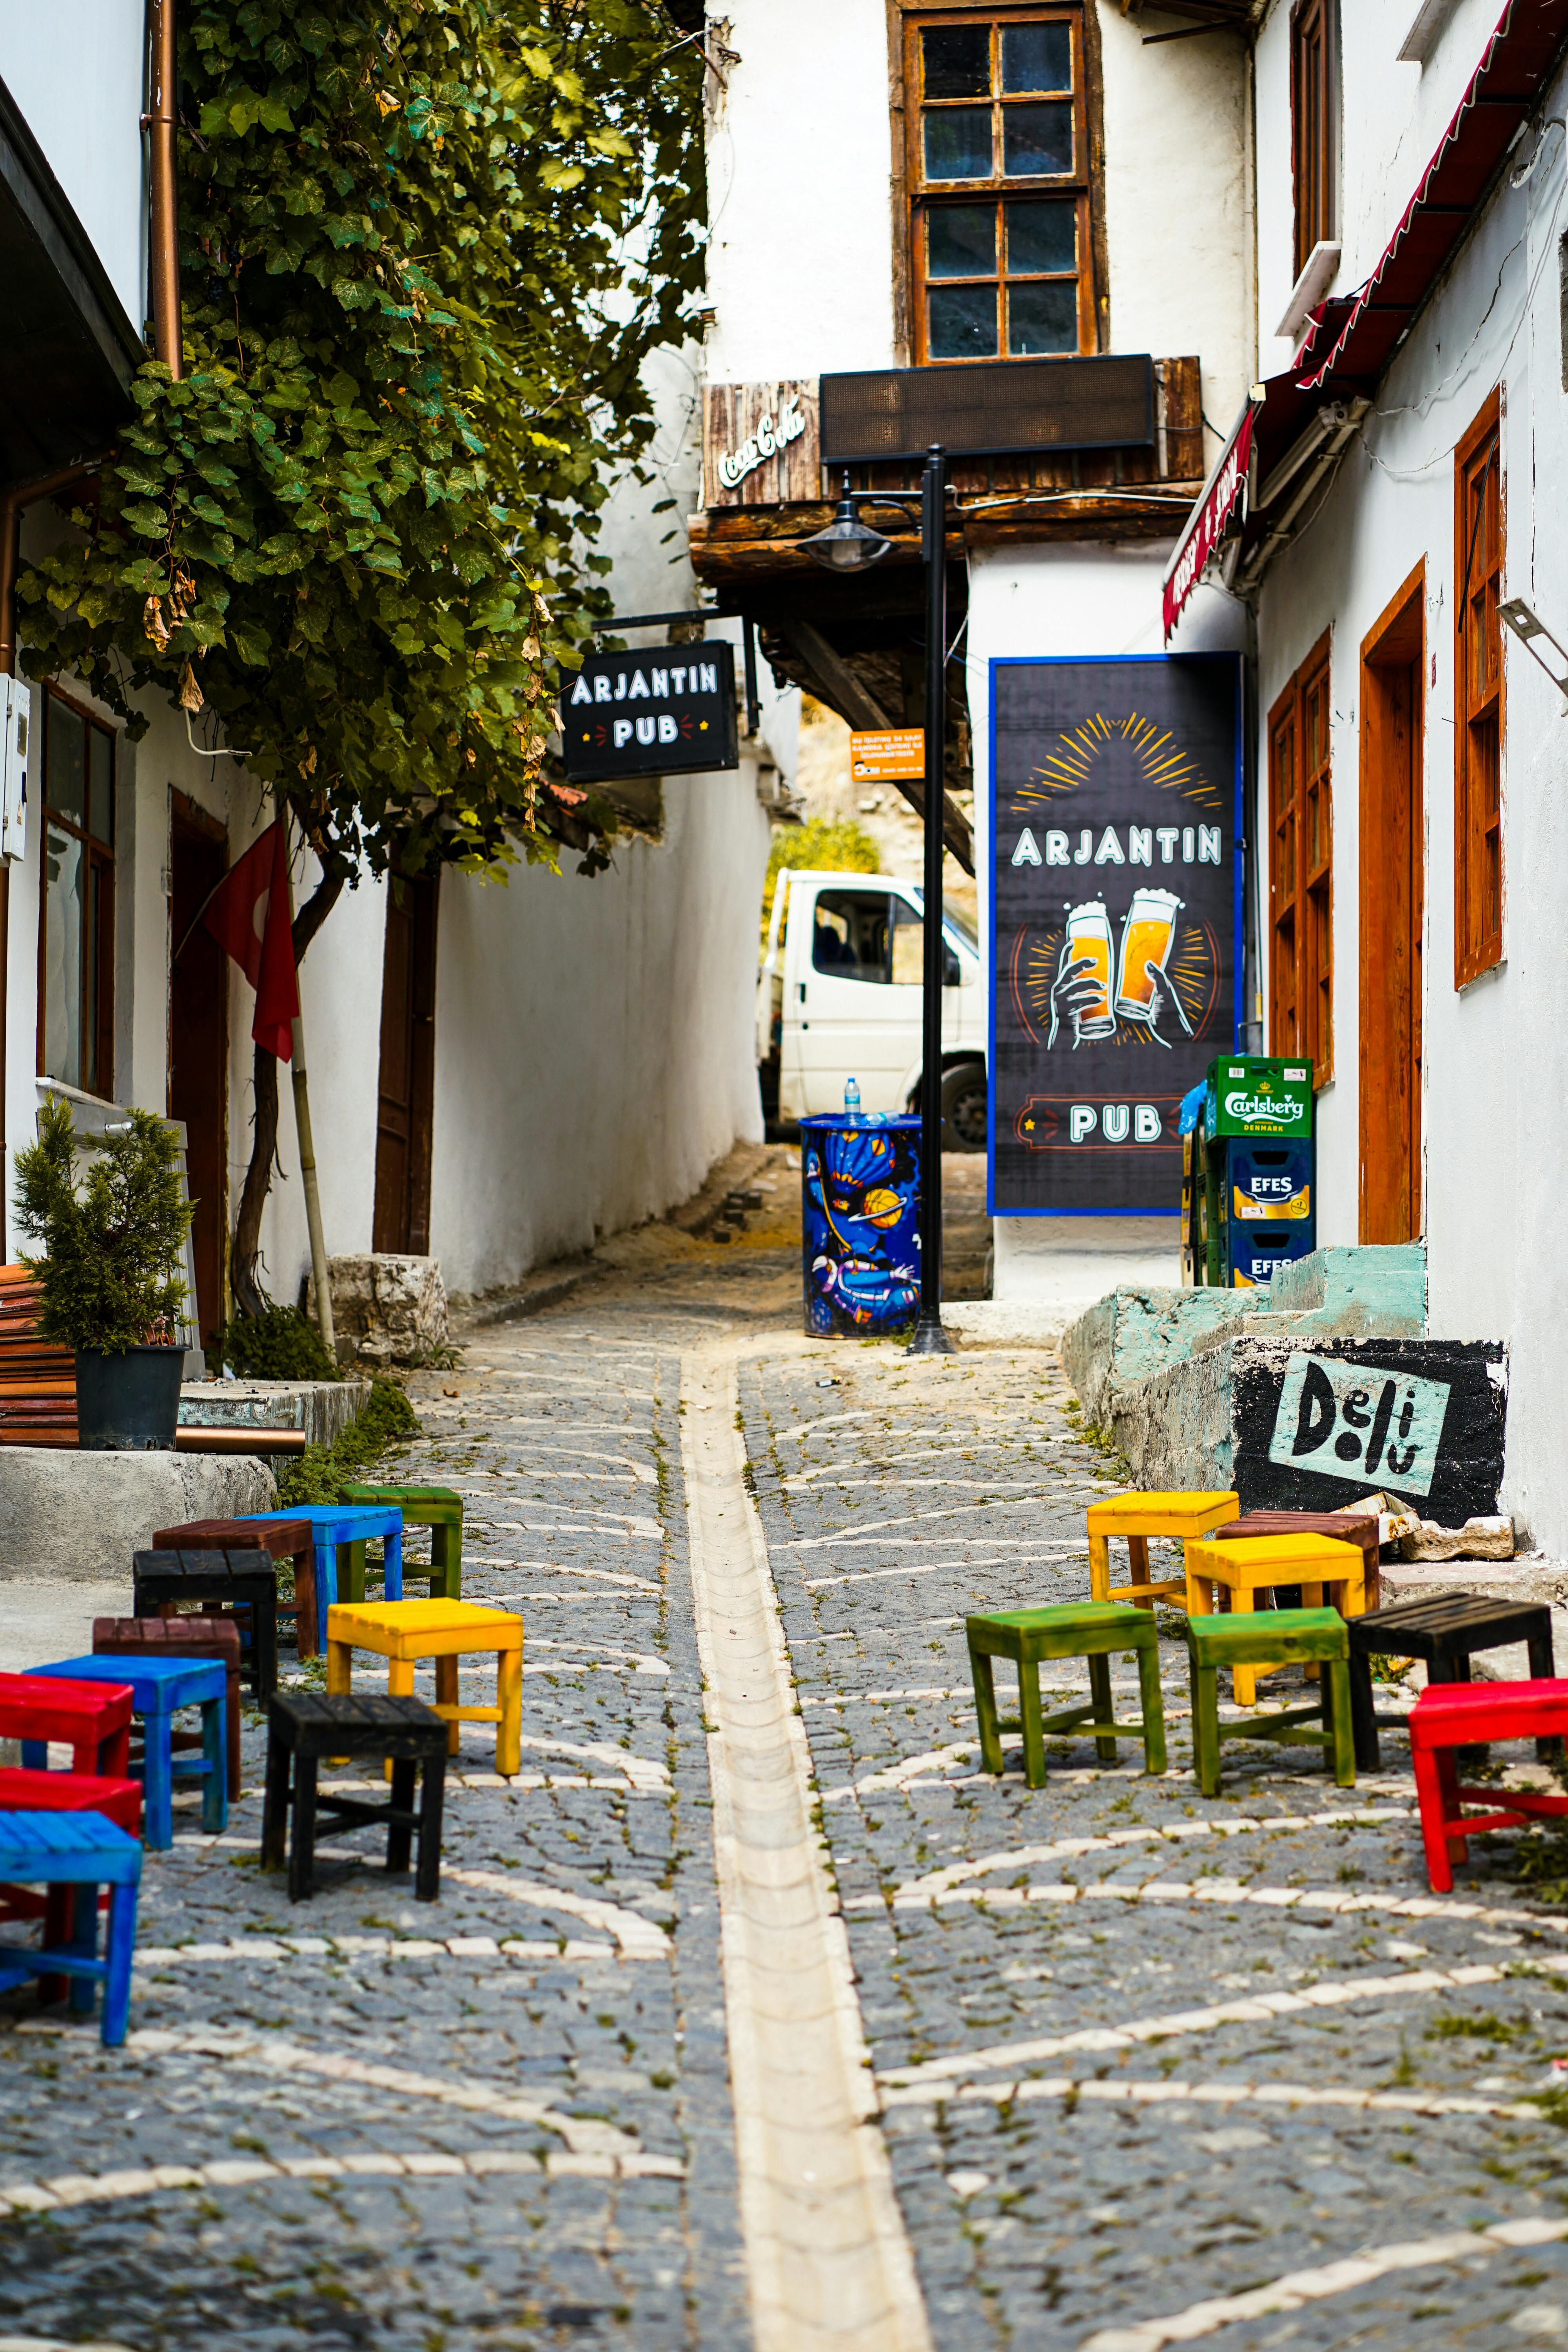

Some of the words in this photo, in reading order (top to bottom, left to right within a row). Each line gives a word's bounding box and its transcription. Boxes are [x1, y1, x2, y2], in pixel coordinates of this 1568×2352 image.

[571, 662, 717, 705] ARJANTIN
[613, 715, 678, 748] PUB
[1011, 824, 1221, 867] ARJANTIN
[1070, 1105, 1162, 1143] PUB
[1225, 1092, 1304, 1123] Carlsberg
[1251, 1177, 1292, 1192] EFES
